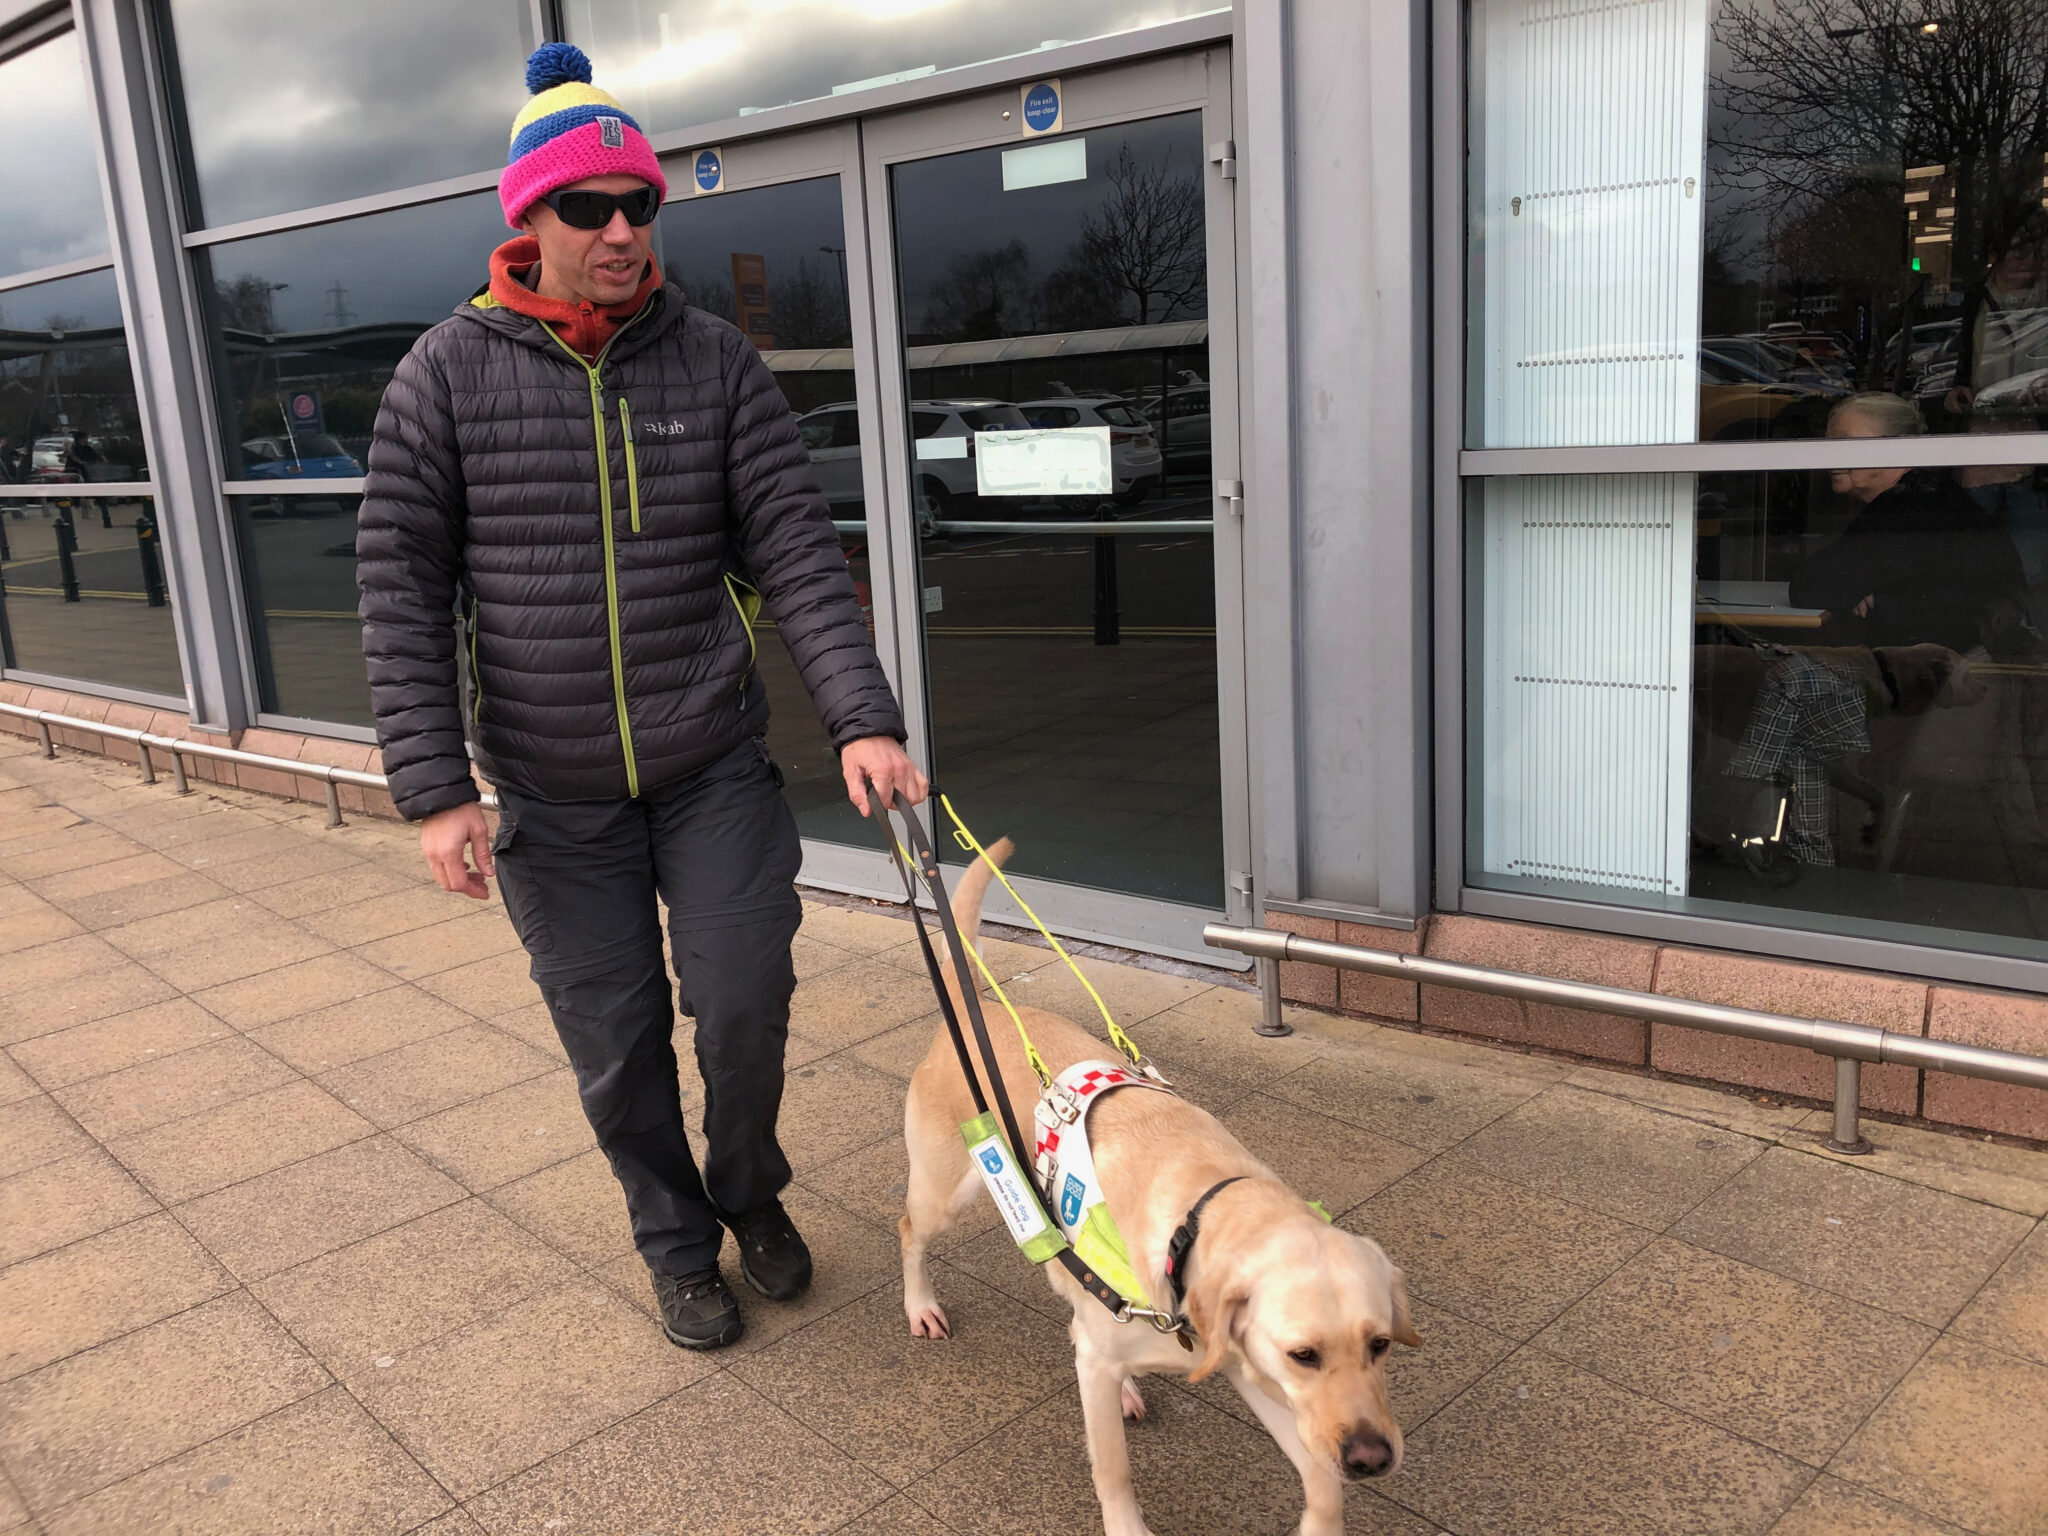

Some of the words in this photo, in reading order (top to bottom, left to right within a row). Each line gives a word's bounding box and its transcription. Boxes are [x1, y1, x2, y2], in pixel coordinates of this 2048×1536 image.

[1030, 99, 1042, 107] Fire
[1027, 109, 1041, 117] keep
[603, 125, 621, 138] YES
[1065, 1183, 1082, 1200] DOGS
[1067, 1178, 1084, 1193] GUIDE
[1004, 1179, 1020, 1203] Guide
[1018, 1204, 1029, 1222] dog
